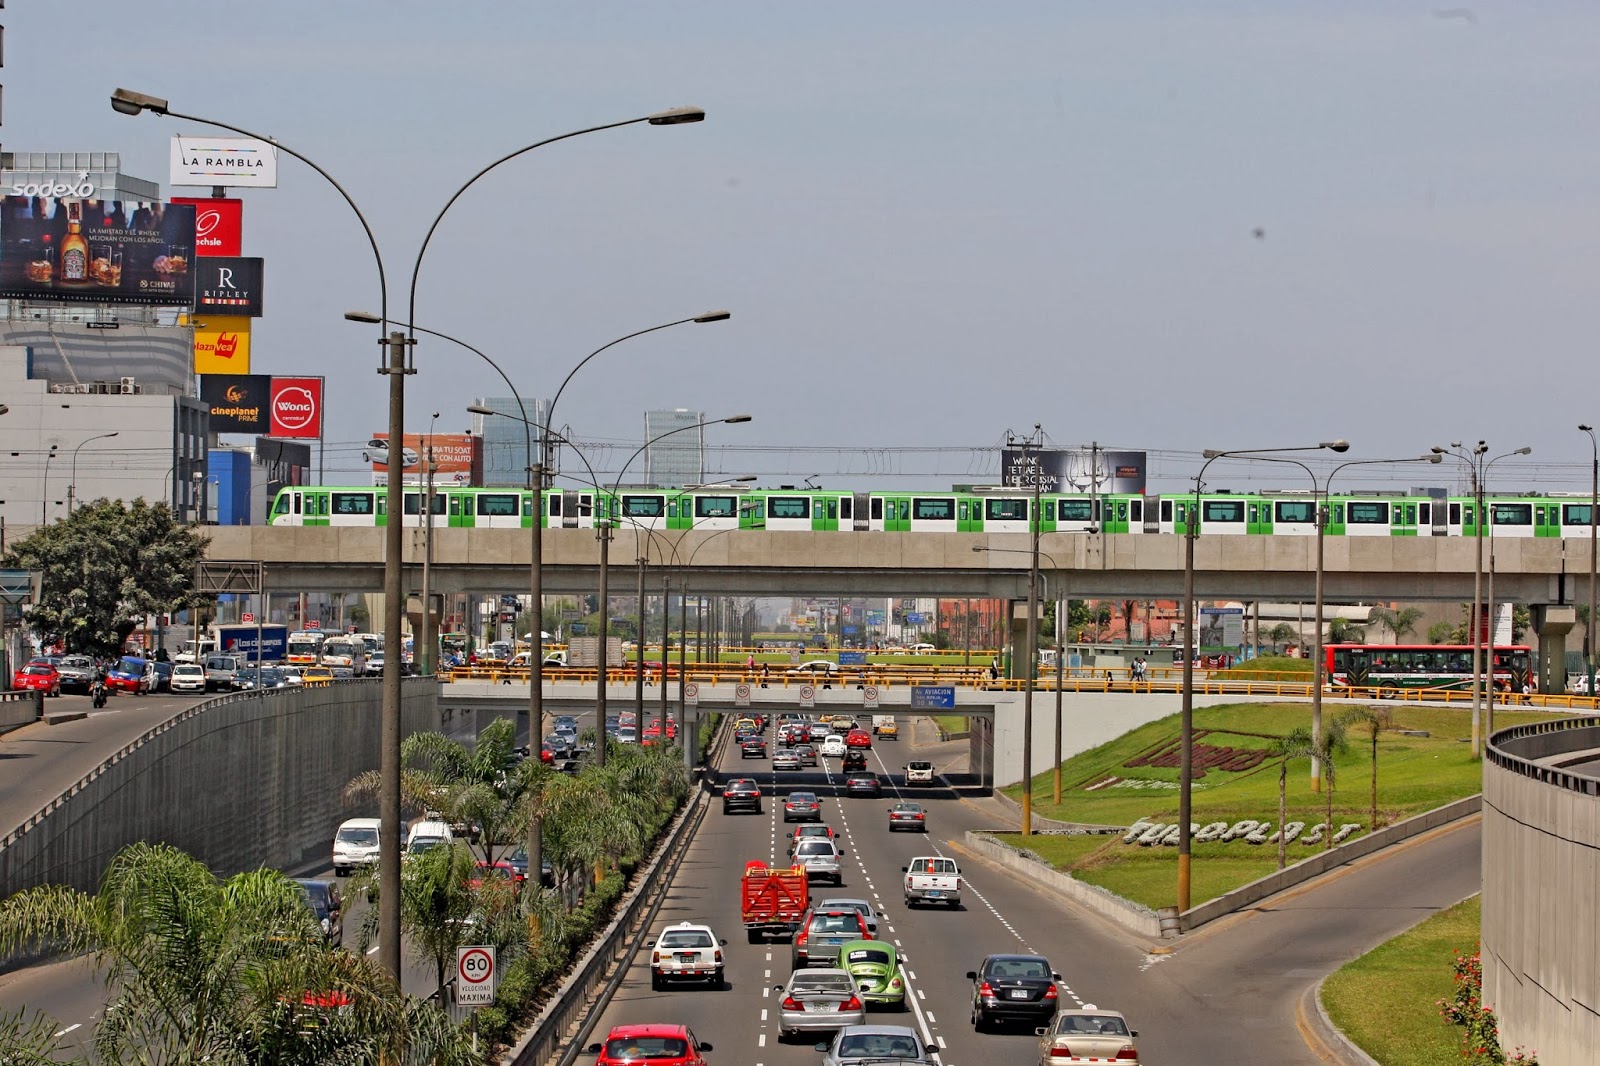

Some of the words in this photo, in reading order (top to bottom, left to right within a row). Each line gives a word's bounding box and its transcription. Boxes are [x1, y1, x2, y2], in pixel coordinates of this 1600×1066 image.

[182, 157, 199, 166] LA
[206, 158, 264, 167] RAMBLA
[10, 177, 94, 198] sodexo
[196, 237, 222, 246] echsle
[218, 267, 237, 289] R
[149, 281, 176, 289] CHIVAS
[204, 290, 249, 298] RIPLEY
[210, 406, 260, 417] cineplanet
[443, 446, 453, 454] TU
[454, 446, 471, 454] SOAT
[439, 454, 453, 462] CON
[238, 637, 251, 647] Los
[251, 637, 282, 647] cineros
[466, 958, 487, 971] 80
[460, 993, 492, 1002] MAXIMA
